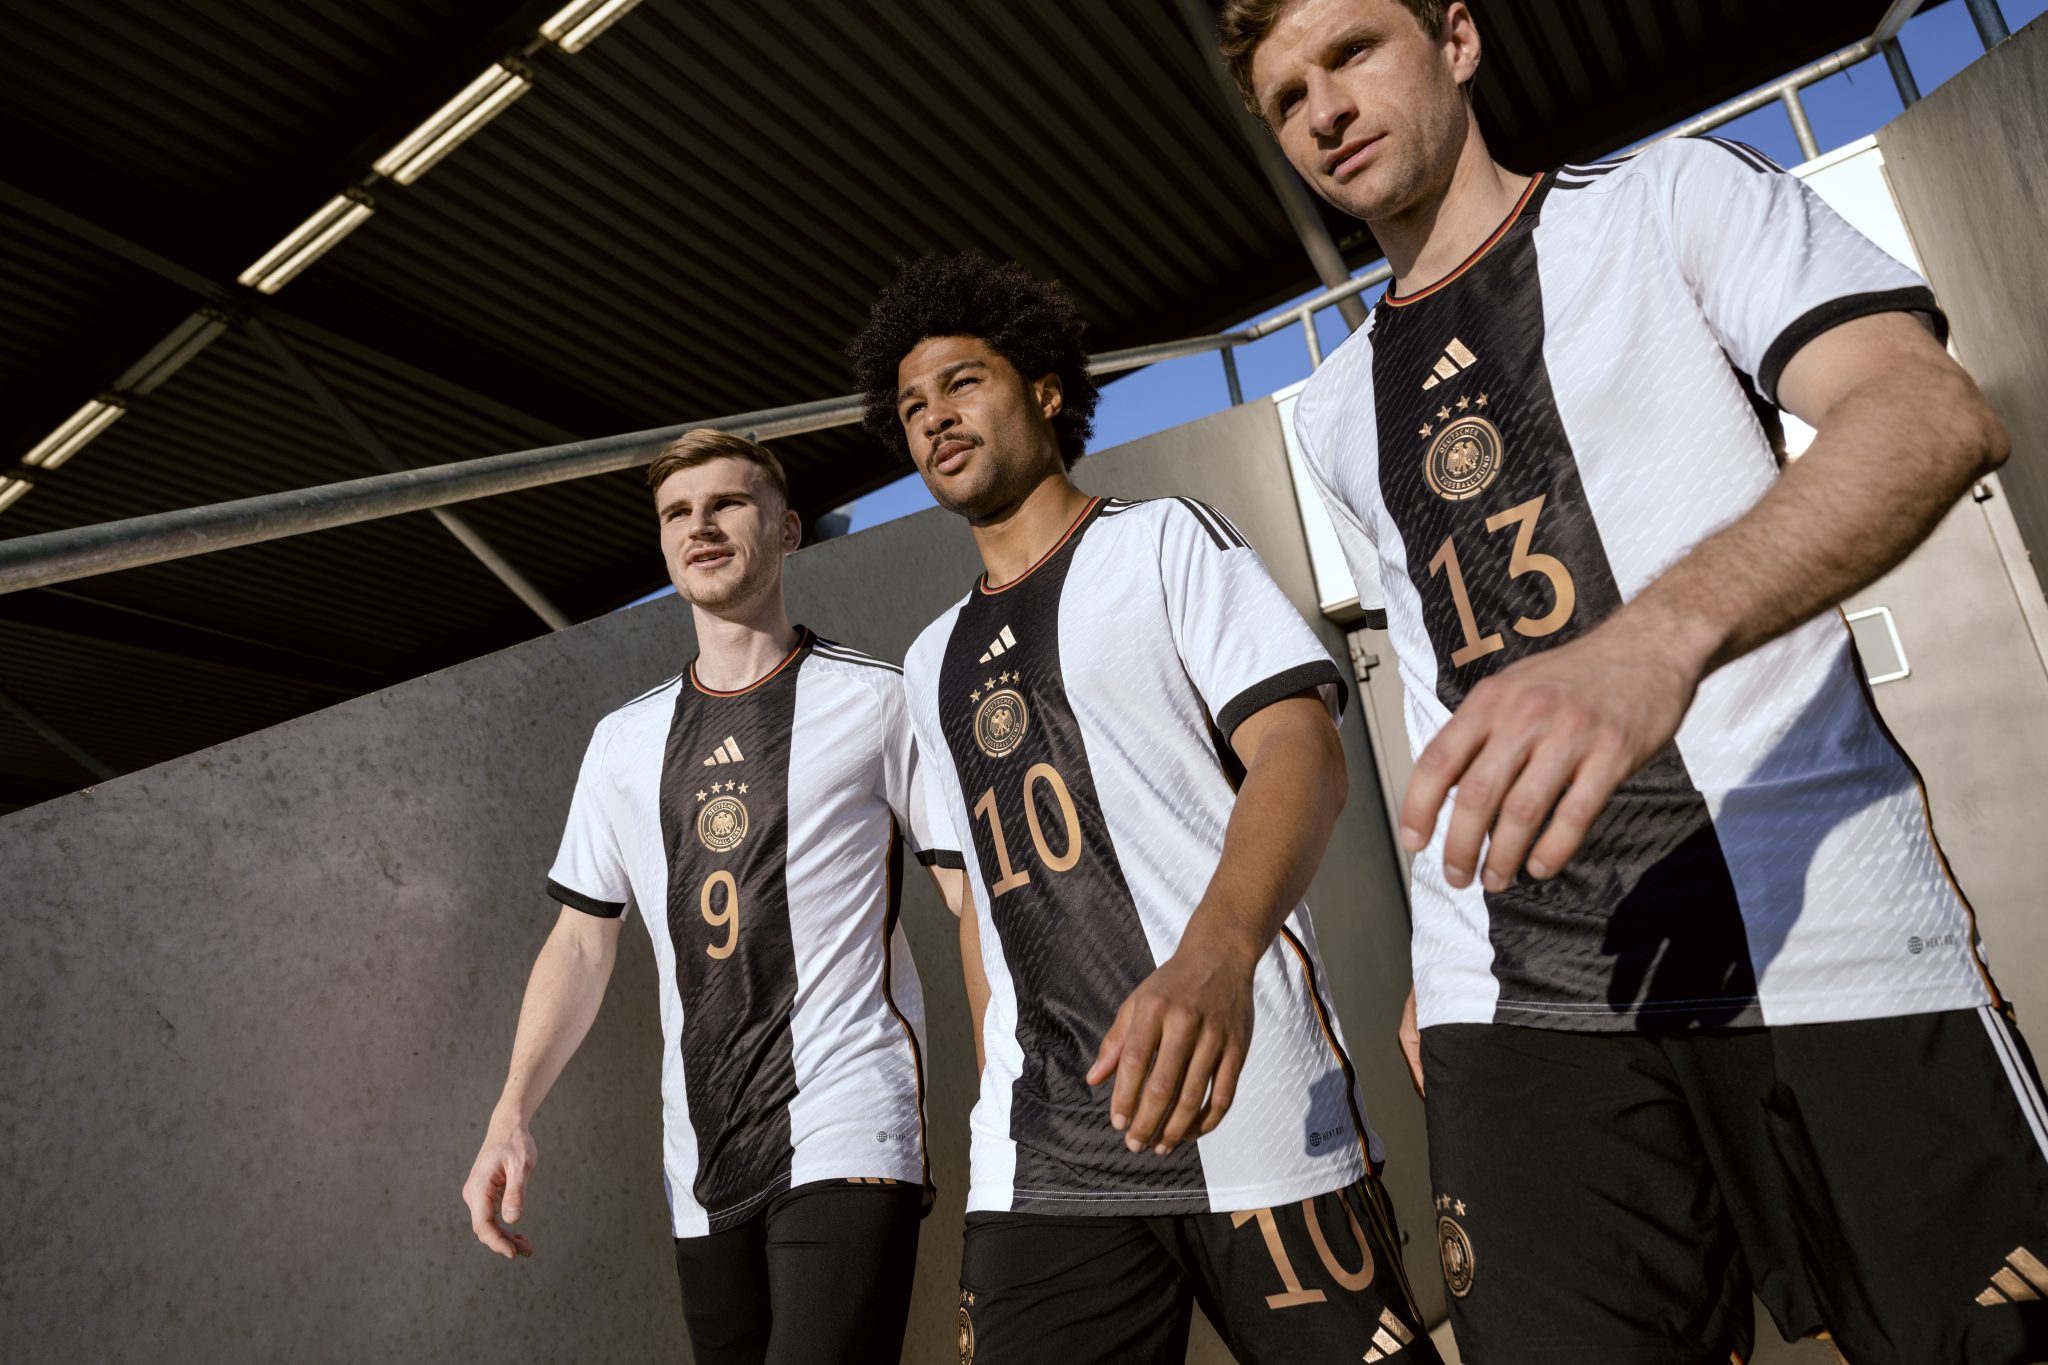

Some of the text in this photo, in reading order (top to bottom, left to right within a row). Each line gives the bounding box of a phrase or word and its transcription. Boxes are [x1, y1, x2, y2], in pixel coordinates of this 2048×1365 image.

[1438, 427, 1479, 454] DEUTSCHER
[1440, 454, 1491, 490] FUSSBALL-BUND
[1428, 493, 1576, 669] 13
[984, 697, 1014, 717] DEUTSCHER
[984, 722, 1020, 749] FUSSBALL-BUND
[707, 802, 737, 816] DEUTSCHER
[974, 762, 1082, 898] 10
[700, 869, 740, 960] 9
[1230, 1189, 1375, 1310] 10
